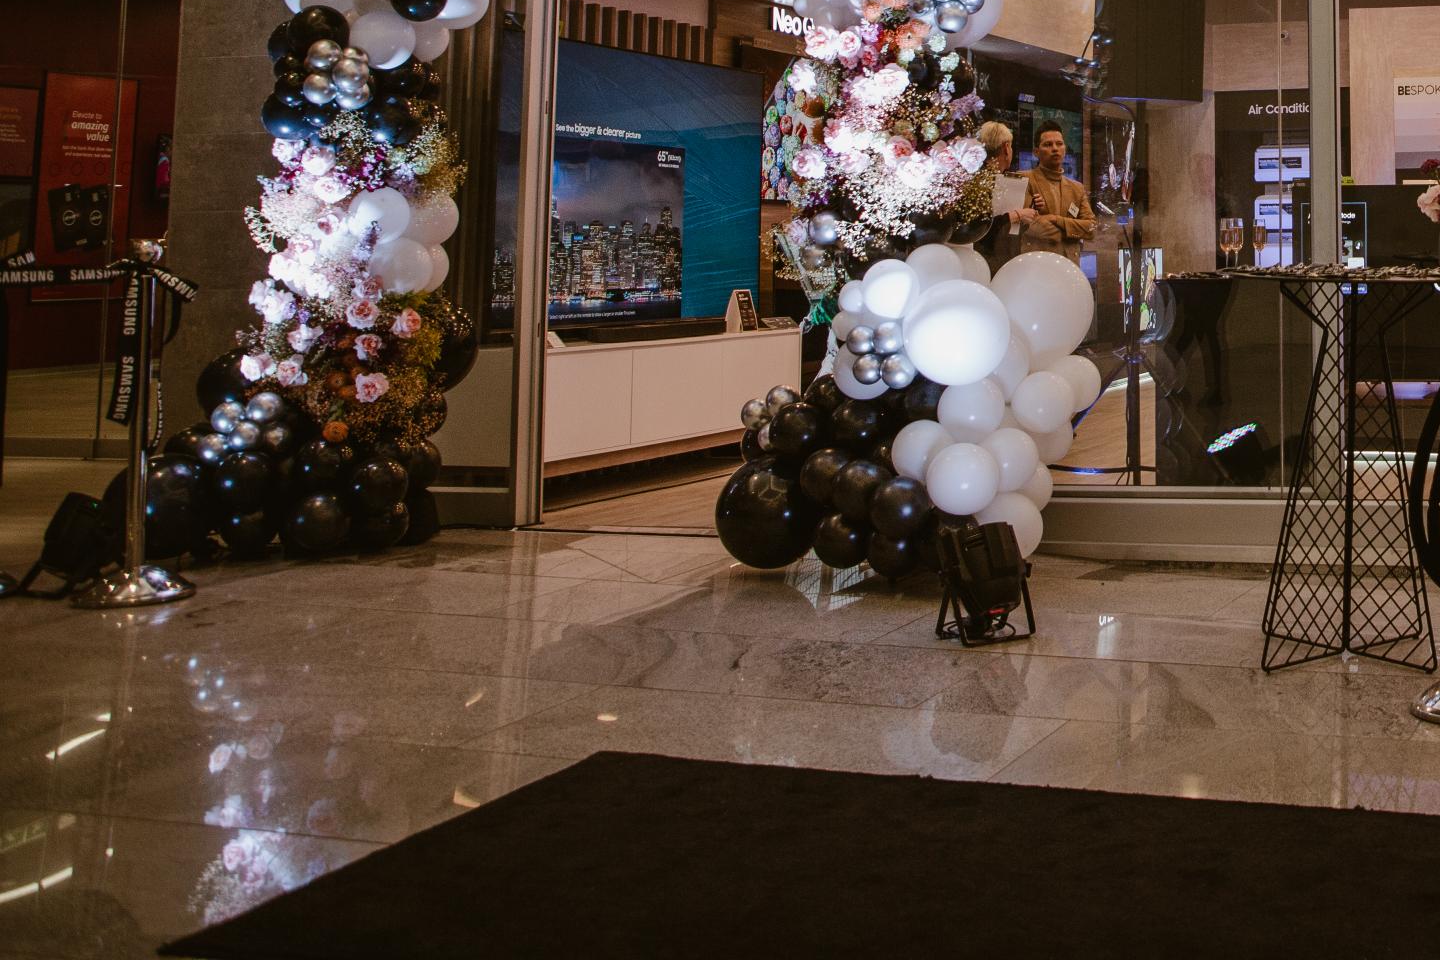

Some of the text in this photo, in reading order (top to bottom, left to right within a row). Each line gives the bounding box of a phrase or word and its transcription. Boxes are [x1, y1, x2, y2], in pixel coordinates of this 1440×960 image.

[772, 6, 801, 36] Neo
[72, 111, 102, 120] Elevate to
[1248, 102, 1310, 115] Air Conditio
[71, 120, 109, 134] amazing
[575, 123, 597, 137] bigger
[597, 126, 603, 136] &
[603, 126, 626, 138] clearer
[625, 131, 642, 140] picture
[86, 131, 110, 142] value
[112, 355, 135, 420] SAMSUNG
